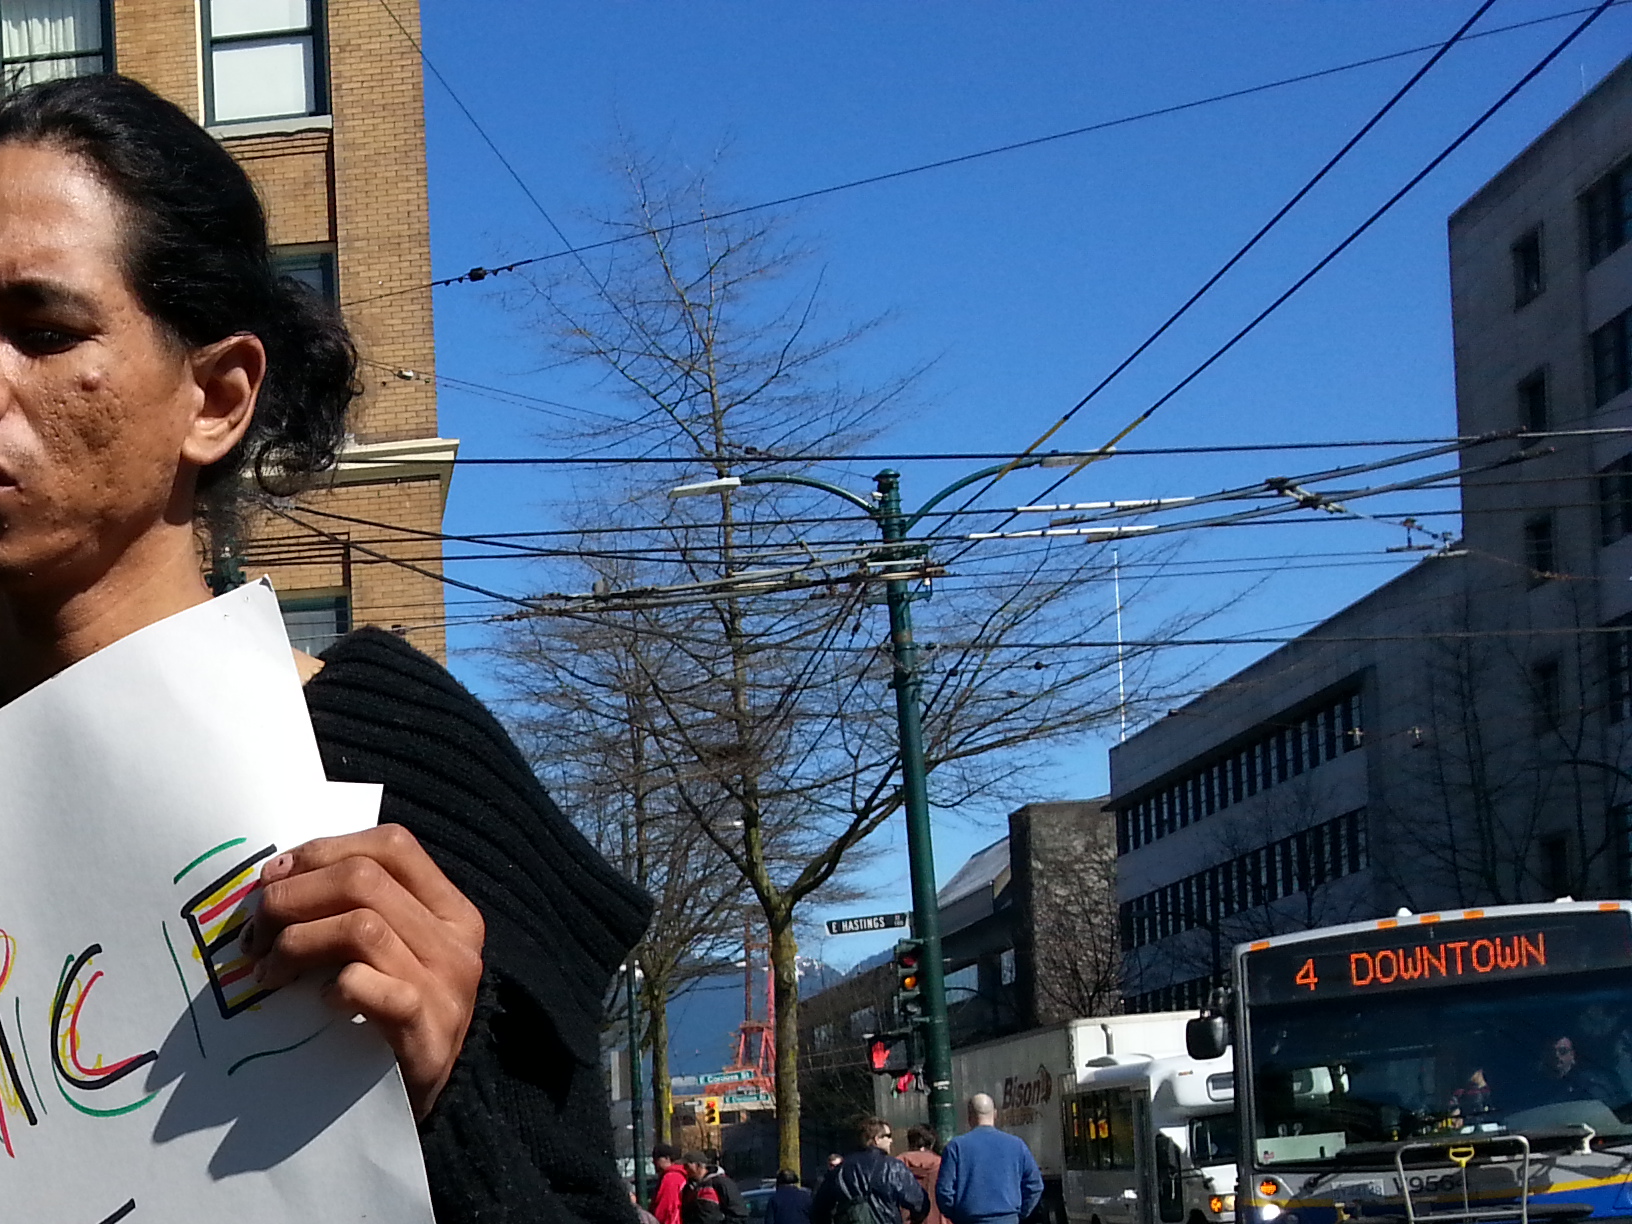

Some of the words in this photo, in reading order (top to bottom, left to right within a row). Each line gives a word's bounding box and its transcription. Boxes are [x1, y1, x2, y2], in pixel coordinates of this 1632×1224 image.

[831, 921, 838, 933] E
[841, 916, 886, 932] HASTINGS
[1295, 957, 1319, 991] 4
[1349, 931, 1547, 987] DOWNTOWN
[1001, 1076, 1041, 1110] Bison
